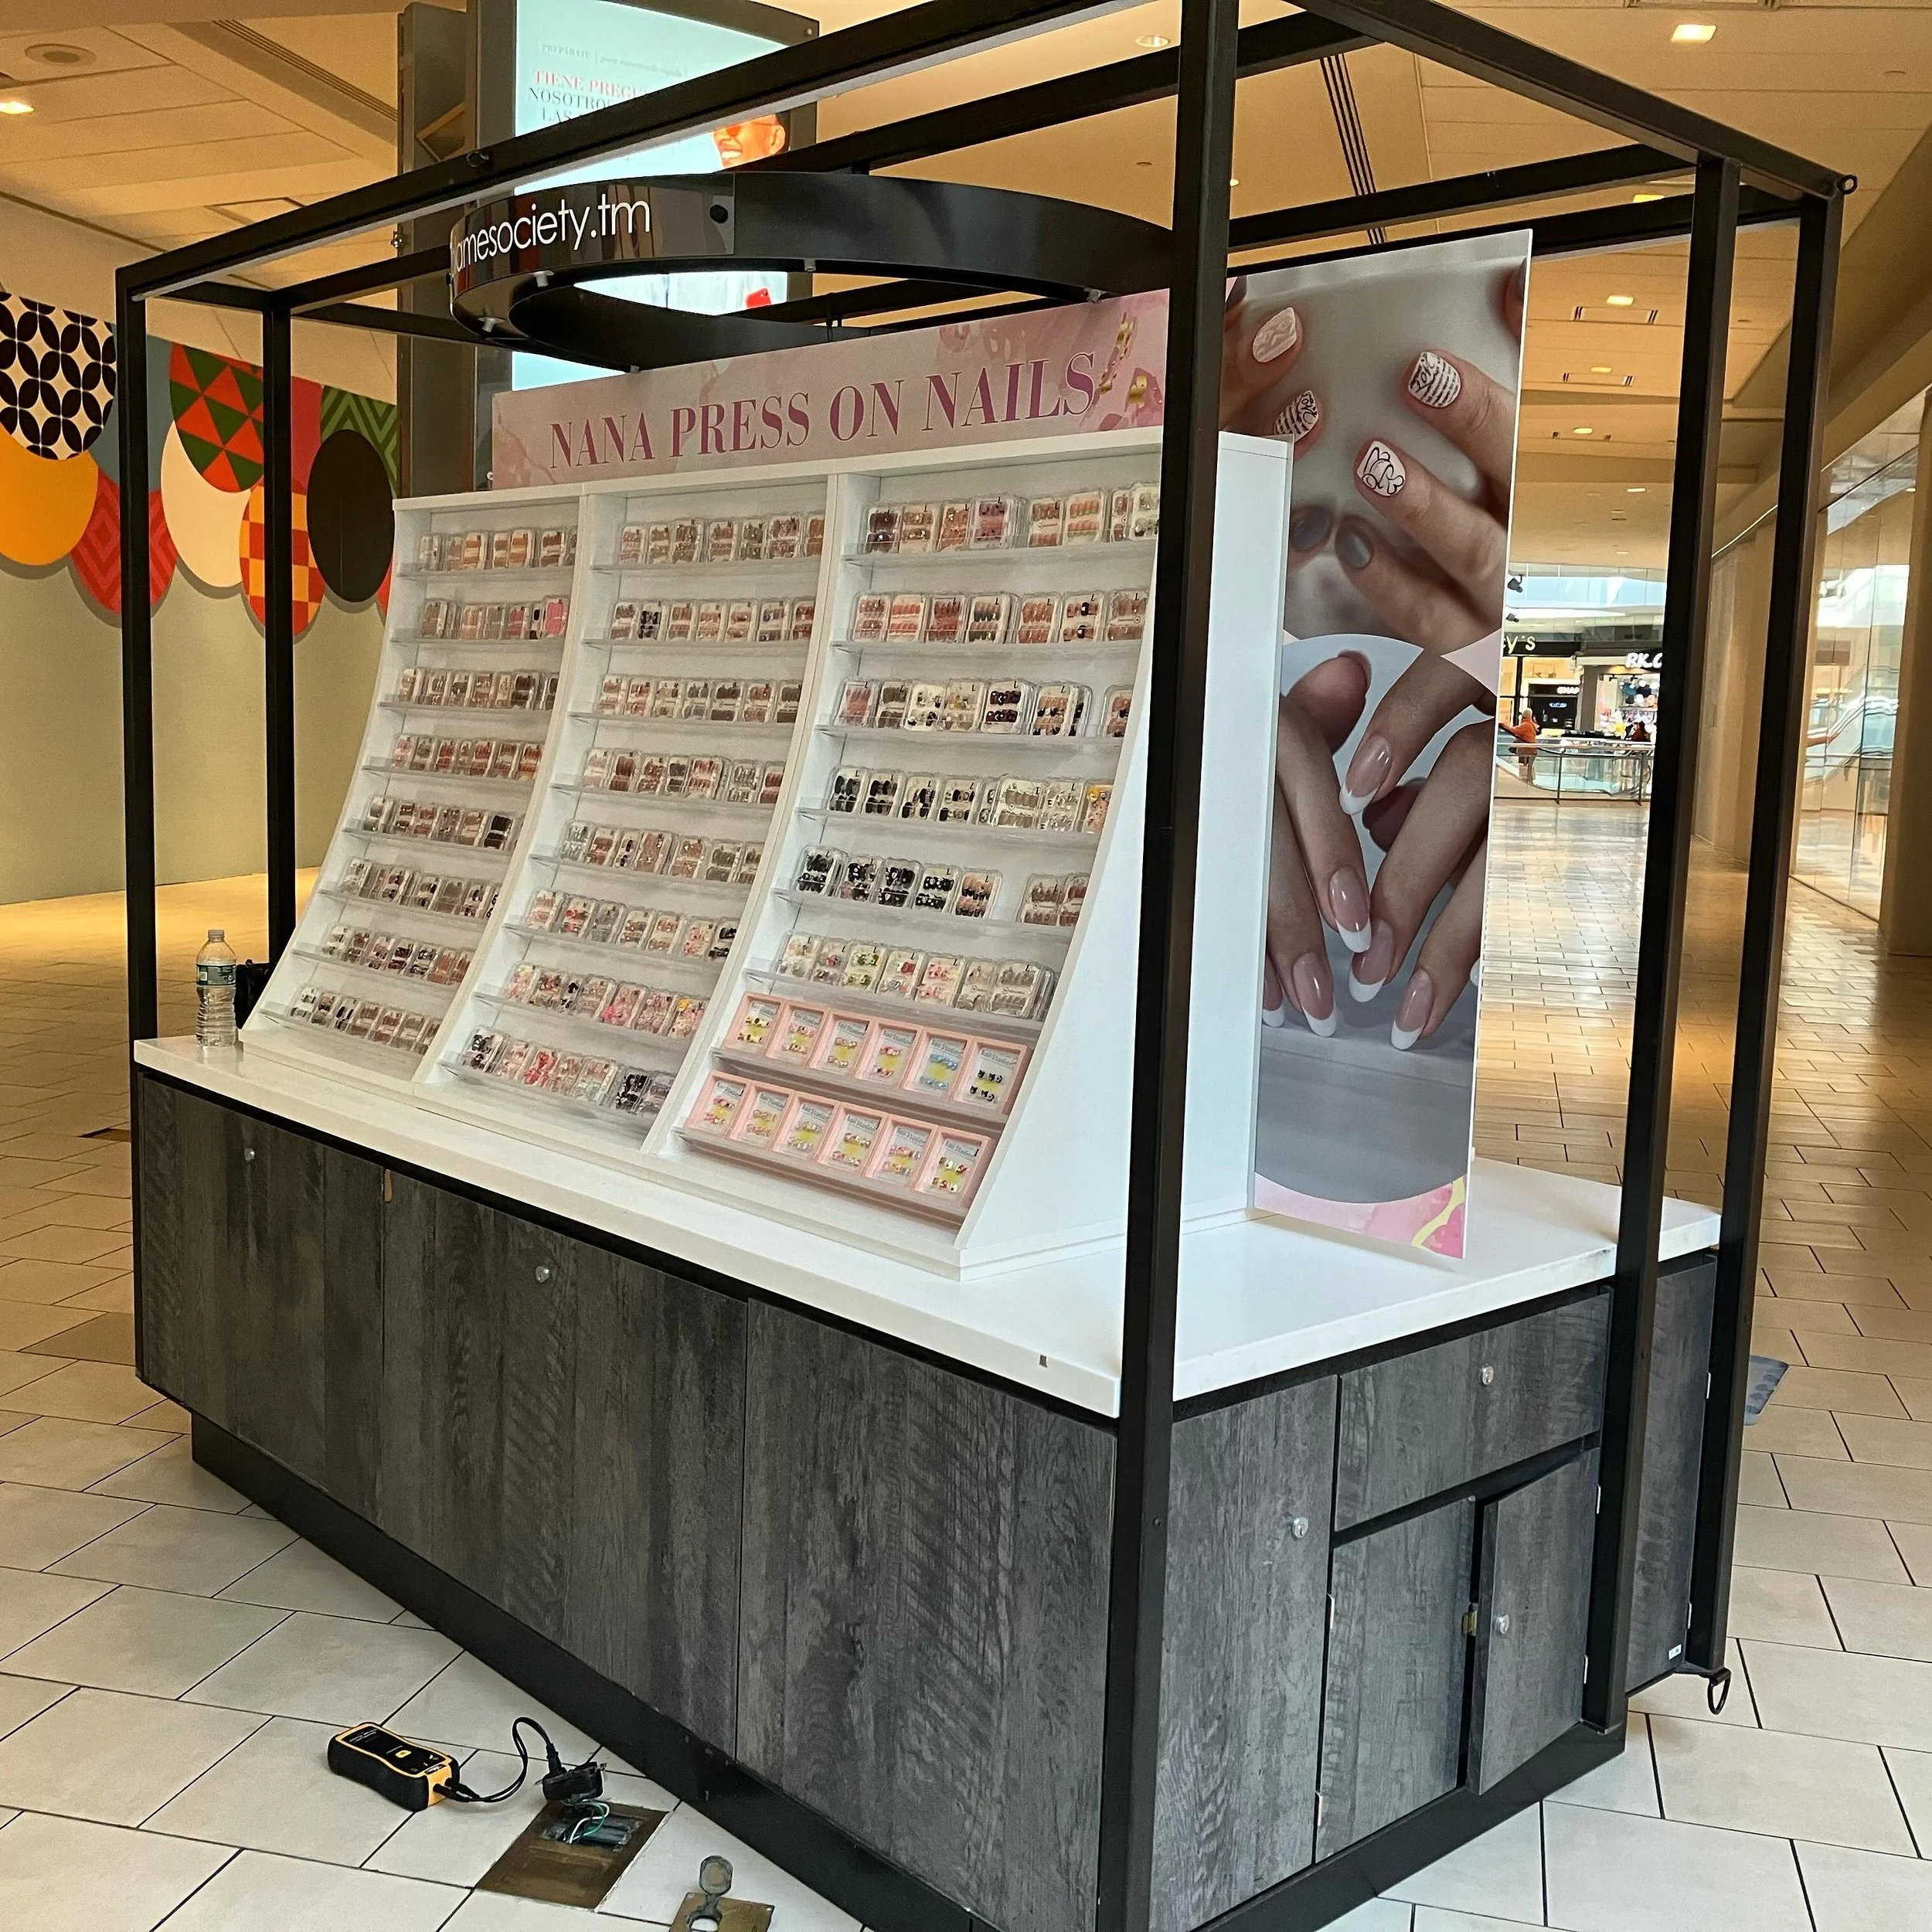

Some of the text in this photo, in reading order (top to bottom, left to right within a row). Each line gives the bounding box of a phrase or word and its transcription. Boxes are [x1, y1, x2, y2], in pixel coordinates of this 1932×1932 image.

[528, 87, 611, 110] NOSOTRO
[532, 69, 648, 99] TIENE PREGU
[454, 193, 651, 273] amesociety.tm
[550, 352, 1097, 469] NANA PRESS ON NAILS
[1503, 635, 1536, 655] y's
